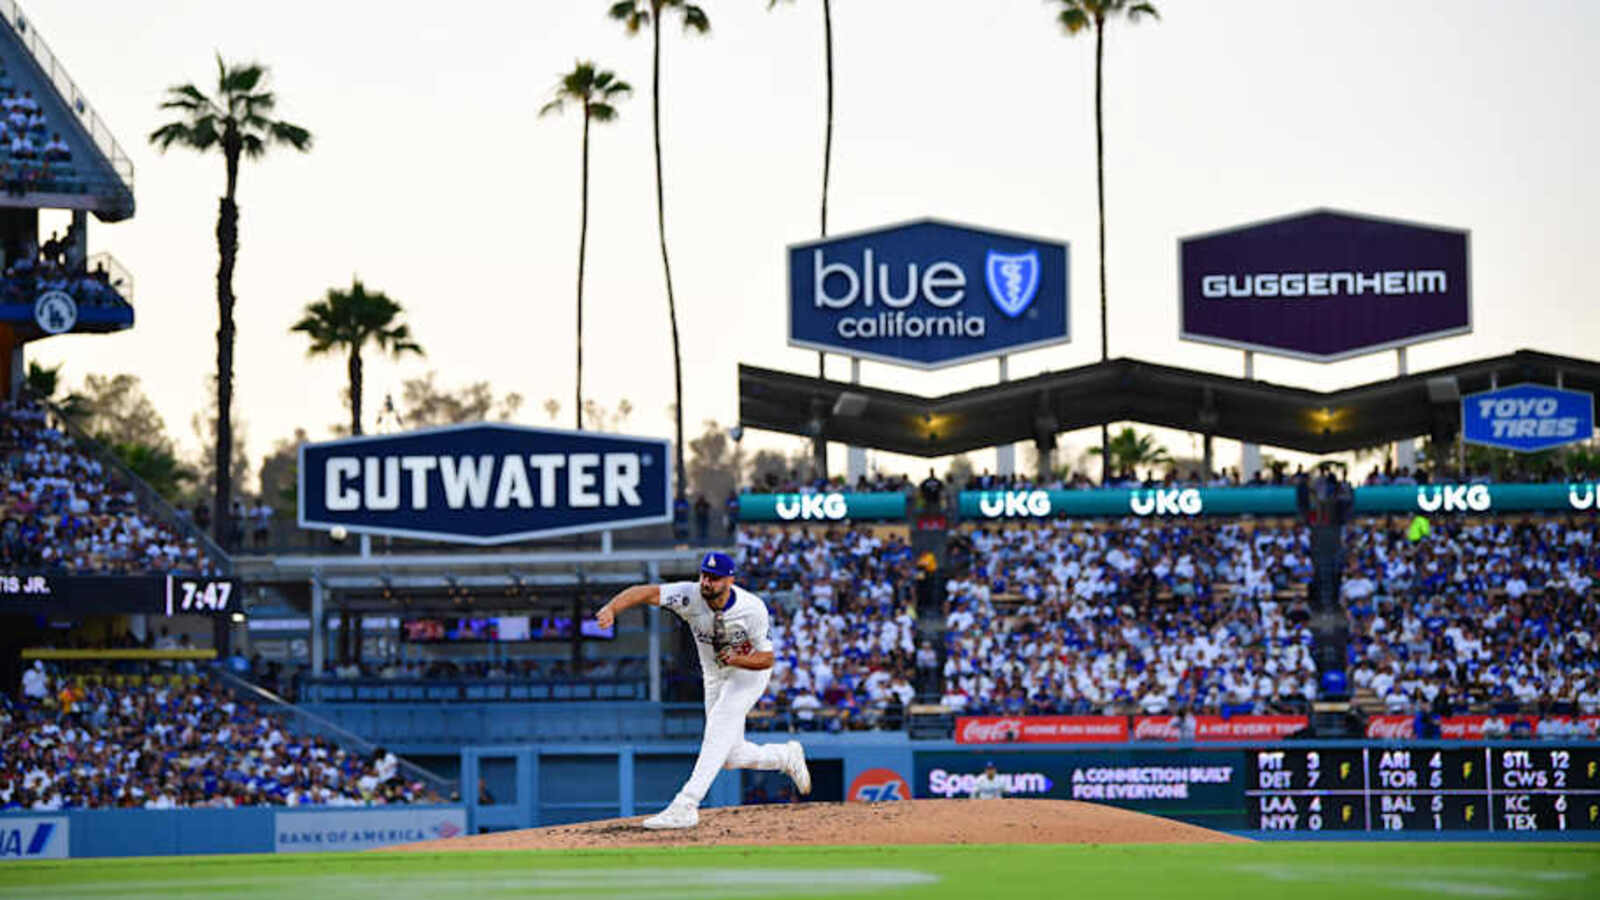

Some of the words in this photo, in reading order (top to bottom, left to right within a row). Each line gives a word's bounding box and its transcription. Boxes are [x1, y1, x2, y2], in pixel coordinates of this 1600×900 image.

[815, 249, 967, 307] blue
[1203, 270, 1447, 297] GUGGENHEIM
[838, 311, 985, 338] california
[1479, 398, 1557, 418] TOYO
[1491, 417, 1578, 438] TIRES
[325, 453, 642, 511] CUTWATER
[775, 493, 848, 519] UKG
[980, 491, 1052, 517] UKG
[1130, 489, 1202, 515] UKG
[1417, 484, 1491, 511] UKG
[23, 576, 51, 594] JR.
[182, 582, 231, 610] 7:47
[1258, 752, 1285, 770] PIT
[1306, 752, 1320, 770] 3
[1379, 752, 1411, 769] ARI
[1429, 751, 1442, 768] 4
[1503, 751, 1533, 769] STL
[1550, 751, 1570, 768] 12
[1073, 768, 1085, 783] A
[1086, 767, 1188, 783] CONNECTION
[1190, 766, 1233, 783] BUILT
[1259, 771, 1293, 788] DET
[1307, 770, 1320, 787] 7
[1340, 762, 1350, 779] F
[1379, 770, 1417, 787] TOR
[1462, 761, 1473, 779] F
[1503, 770, 1548, 788] CWS
[1553, 770, 1566, 788] 2
[1587, 761, 1598, 779] F
[856, 780, 904, 801] 76
[1073, 783, 1103, 798] FOR
[1106, 783, 1188, 799] EVERYONE
[1261, 796, 1297, 812] LAA
[1309, 796, 1322, 812] 4
[1381, 796, 1415, 812] BAL
[1505, 795, 1530, 811] KC
[1555, 795, 1567, 812] 6
[1261, 814, 1299, 830] NYY
[1309, 814, 1322, 830] 0
[1342, 805, 1352, 822] F
[1381, 814, 1403, 830] TB
[1433, 814, 1442, 830] 1
[1465, 804, 1475, 822] F
[1504, 814, 1537, 830] TEX
[1558, 814, 1566, 830] 1
[1589, 804, 1599, 822] F
[279, 832, 322, 844] BANK
[328, 830, 347, 843] OF
[353, 829, 424, 842] AMERICA
